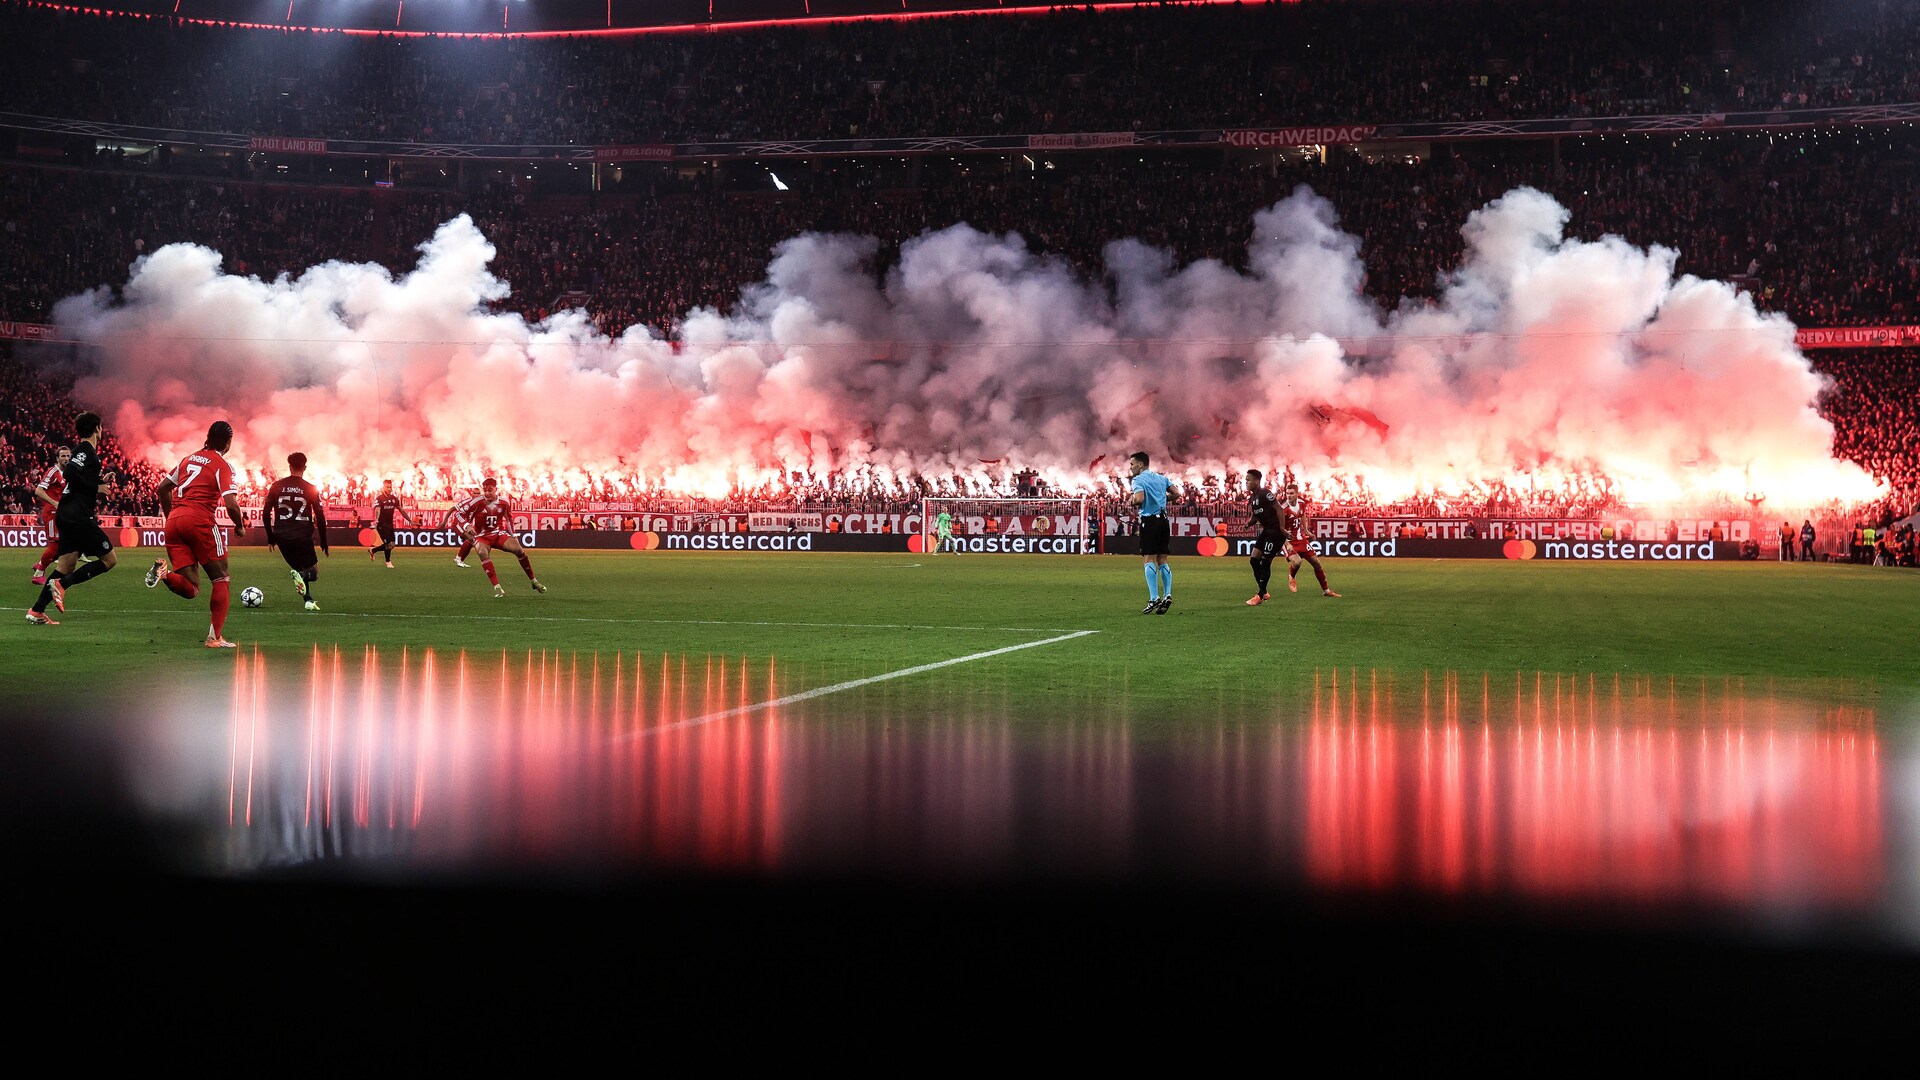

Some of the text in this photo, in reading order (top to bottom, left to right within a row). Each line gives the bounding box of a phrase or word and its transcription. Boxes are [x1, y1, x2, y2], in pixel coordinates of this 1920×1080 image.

[251, 138, 326, 152] STADT LAND ROT
[1030, 134, 1132, 146] Erfordia Bavaria
[597, 148, 672, 157] RED RELIGION
[178, 463, 202, 498] 7
[278, 495, 310, 521] 52
[486, 515, 498, 528] T
[753, 517, 773, 527] RED
[667, 532, 811, 551] mastercard
[1236, 539, 1396, 557] mercard
[1264, 541, 1274, 552] 10
[1545, 539, 1714, 560] mastercard
